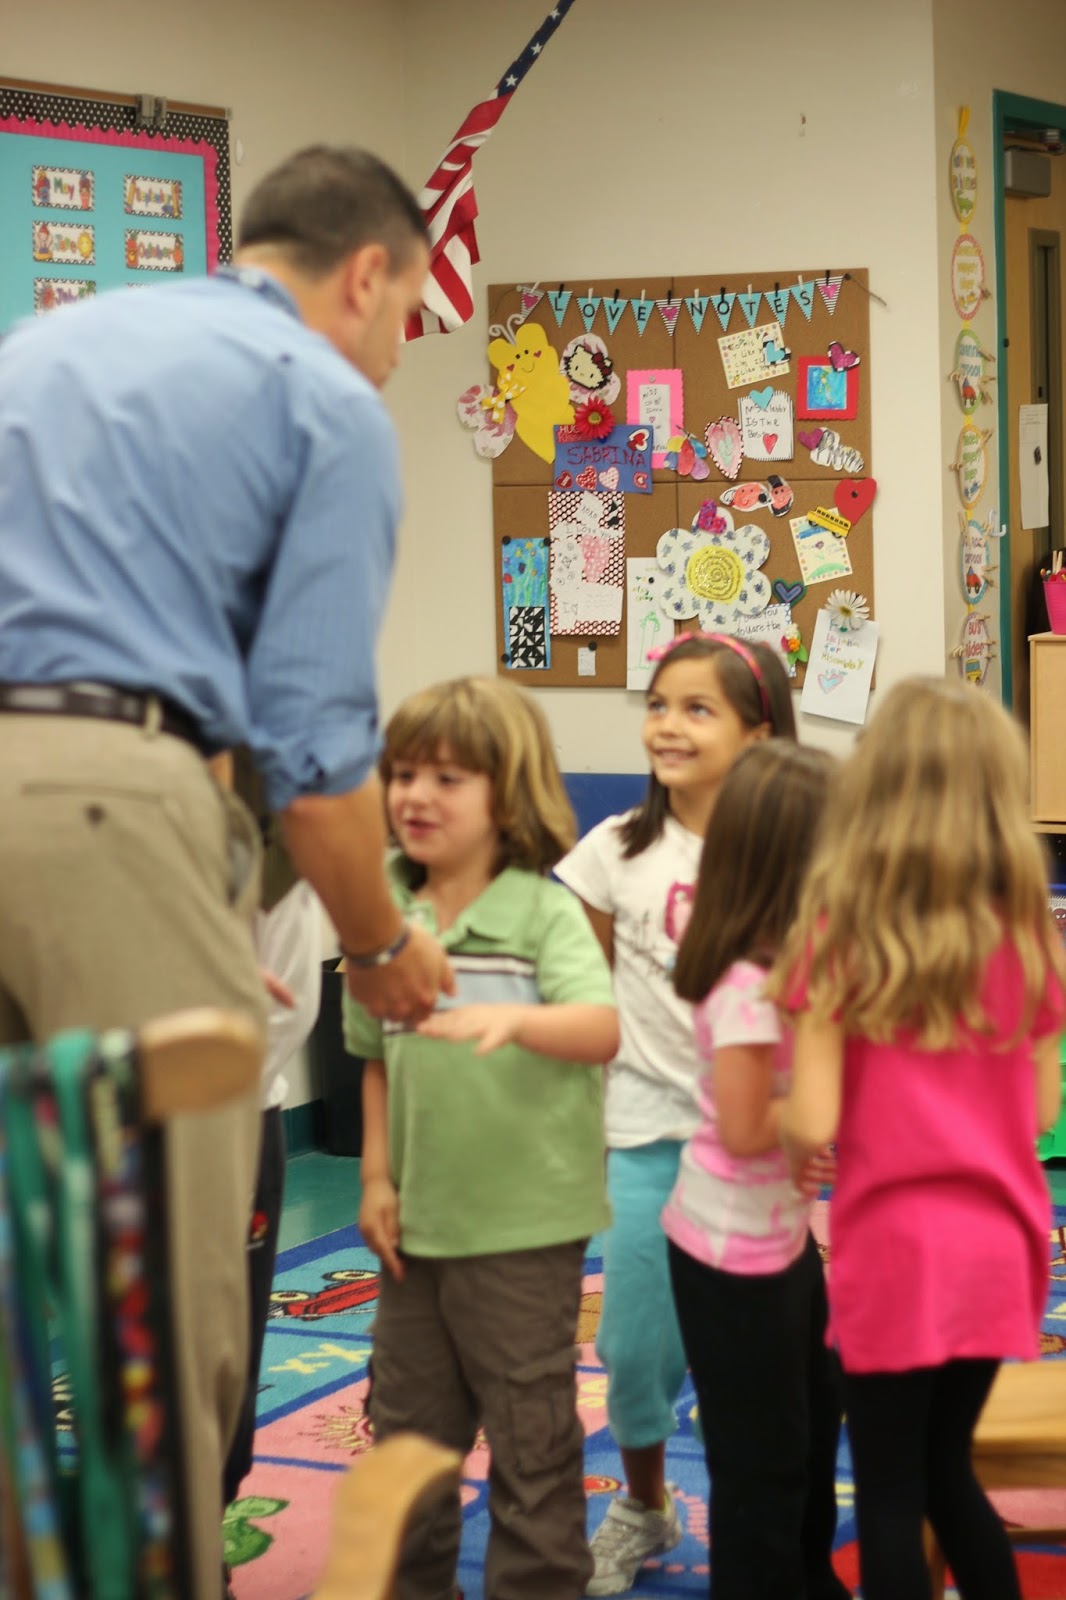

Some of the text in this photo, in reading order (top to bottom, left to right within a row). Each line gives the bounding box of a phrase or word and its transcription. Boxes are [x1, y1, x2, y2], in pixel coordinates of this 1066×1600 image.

[54, 176, 76, 201] May
[55, 286, 79, 306] Jul
[553, 290, 811, 322] LOVE NOTES
[566, 445, 647, 468] SABRINA
